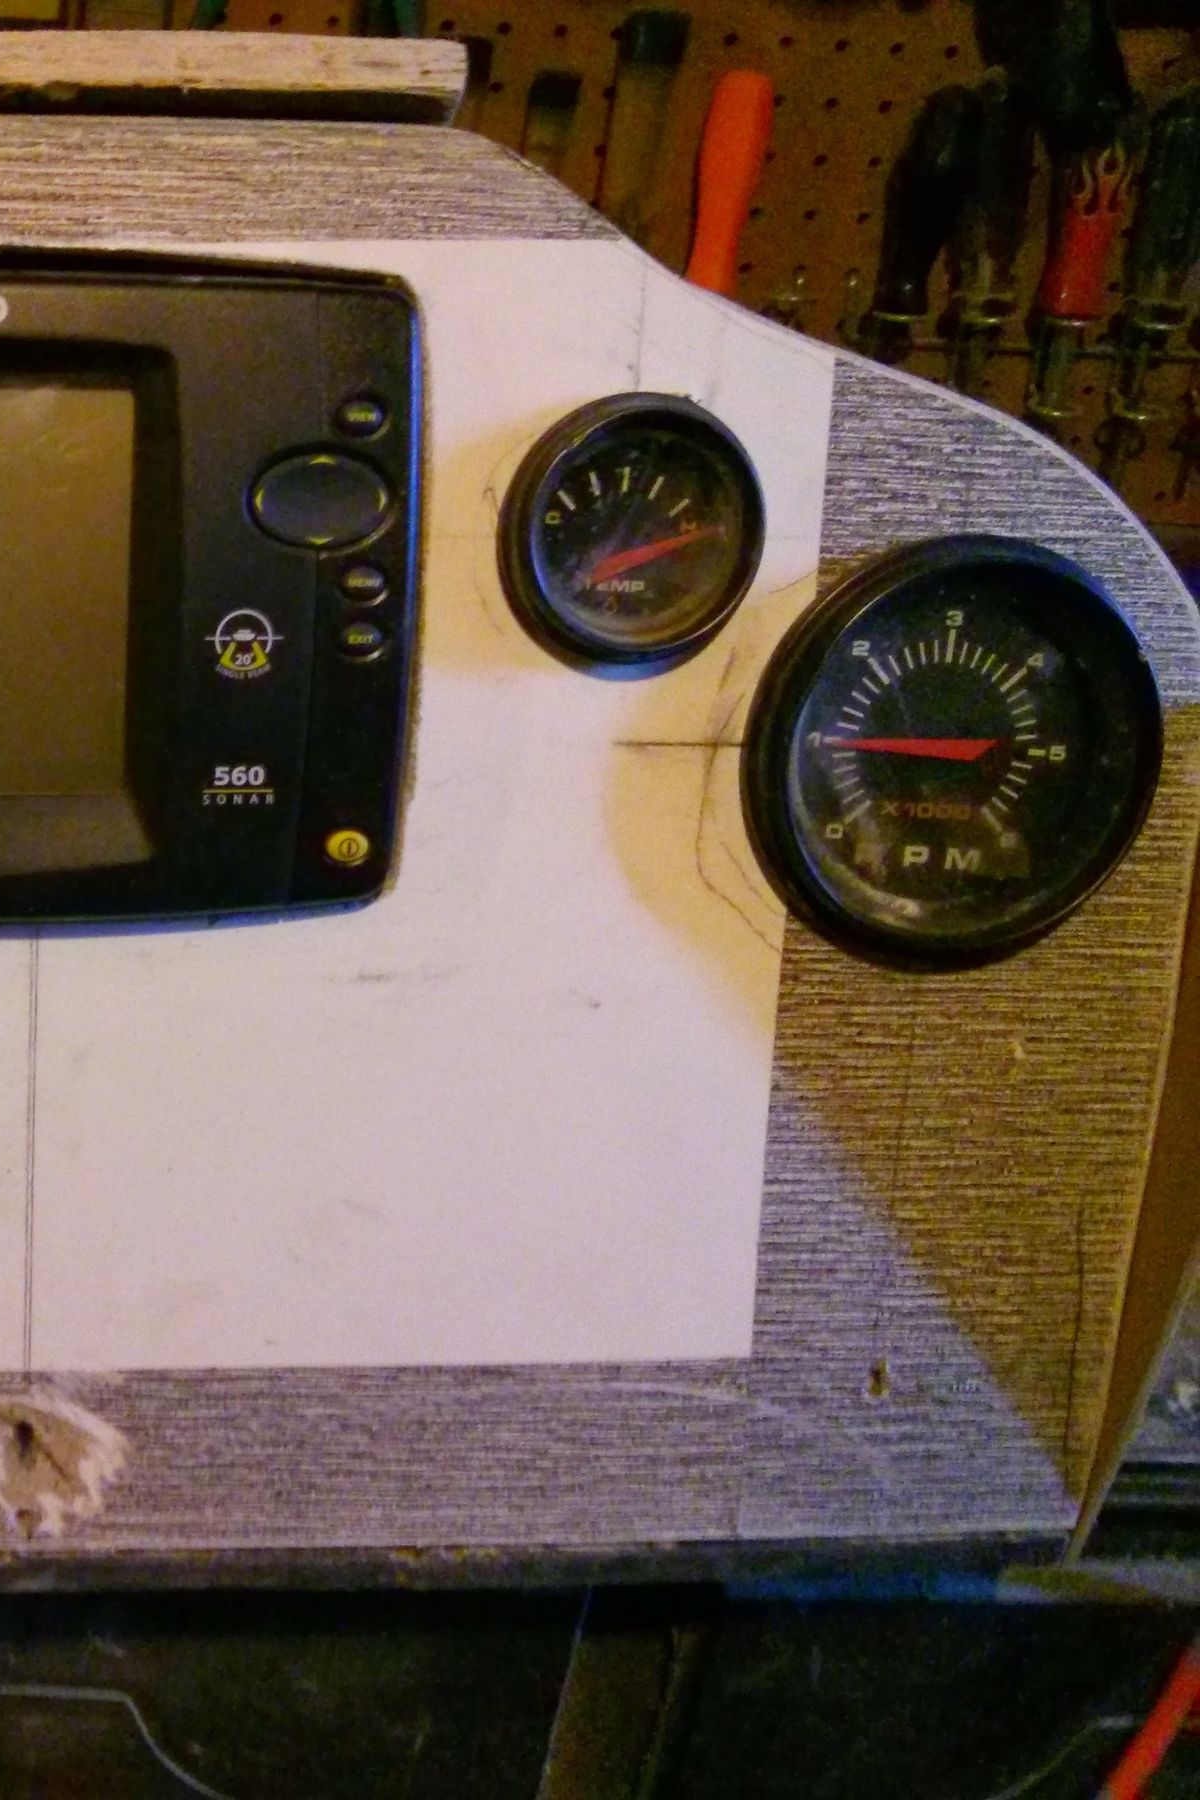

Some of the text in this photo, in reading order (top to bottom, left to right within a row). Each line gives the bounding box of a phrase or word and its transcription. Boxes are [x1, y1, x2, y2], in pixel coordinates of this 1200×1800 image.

[544, 511, 562, 525] C
[946, 610, 964, 627] 3
[852, 639, 871, 657] 2
[1027, 652, 1045, 668] 4
[807, 731, 822, 748] 1
[1049, 745, 1067, 761] 5
[213, 765, 266, 787] 560
[202, 793, 275, 806] SONAR
[825, 824, 845, 840] 0
